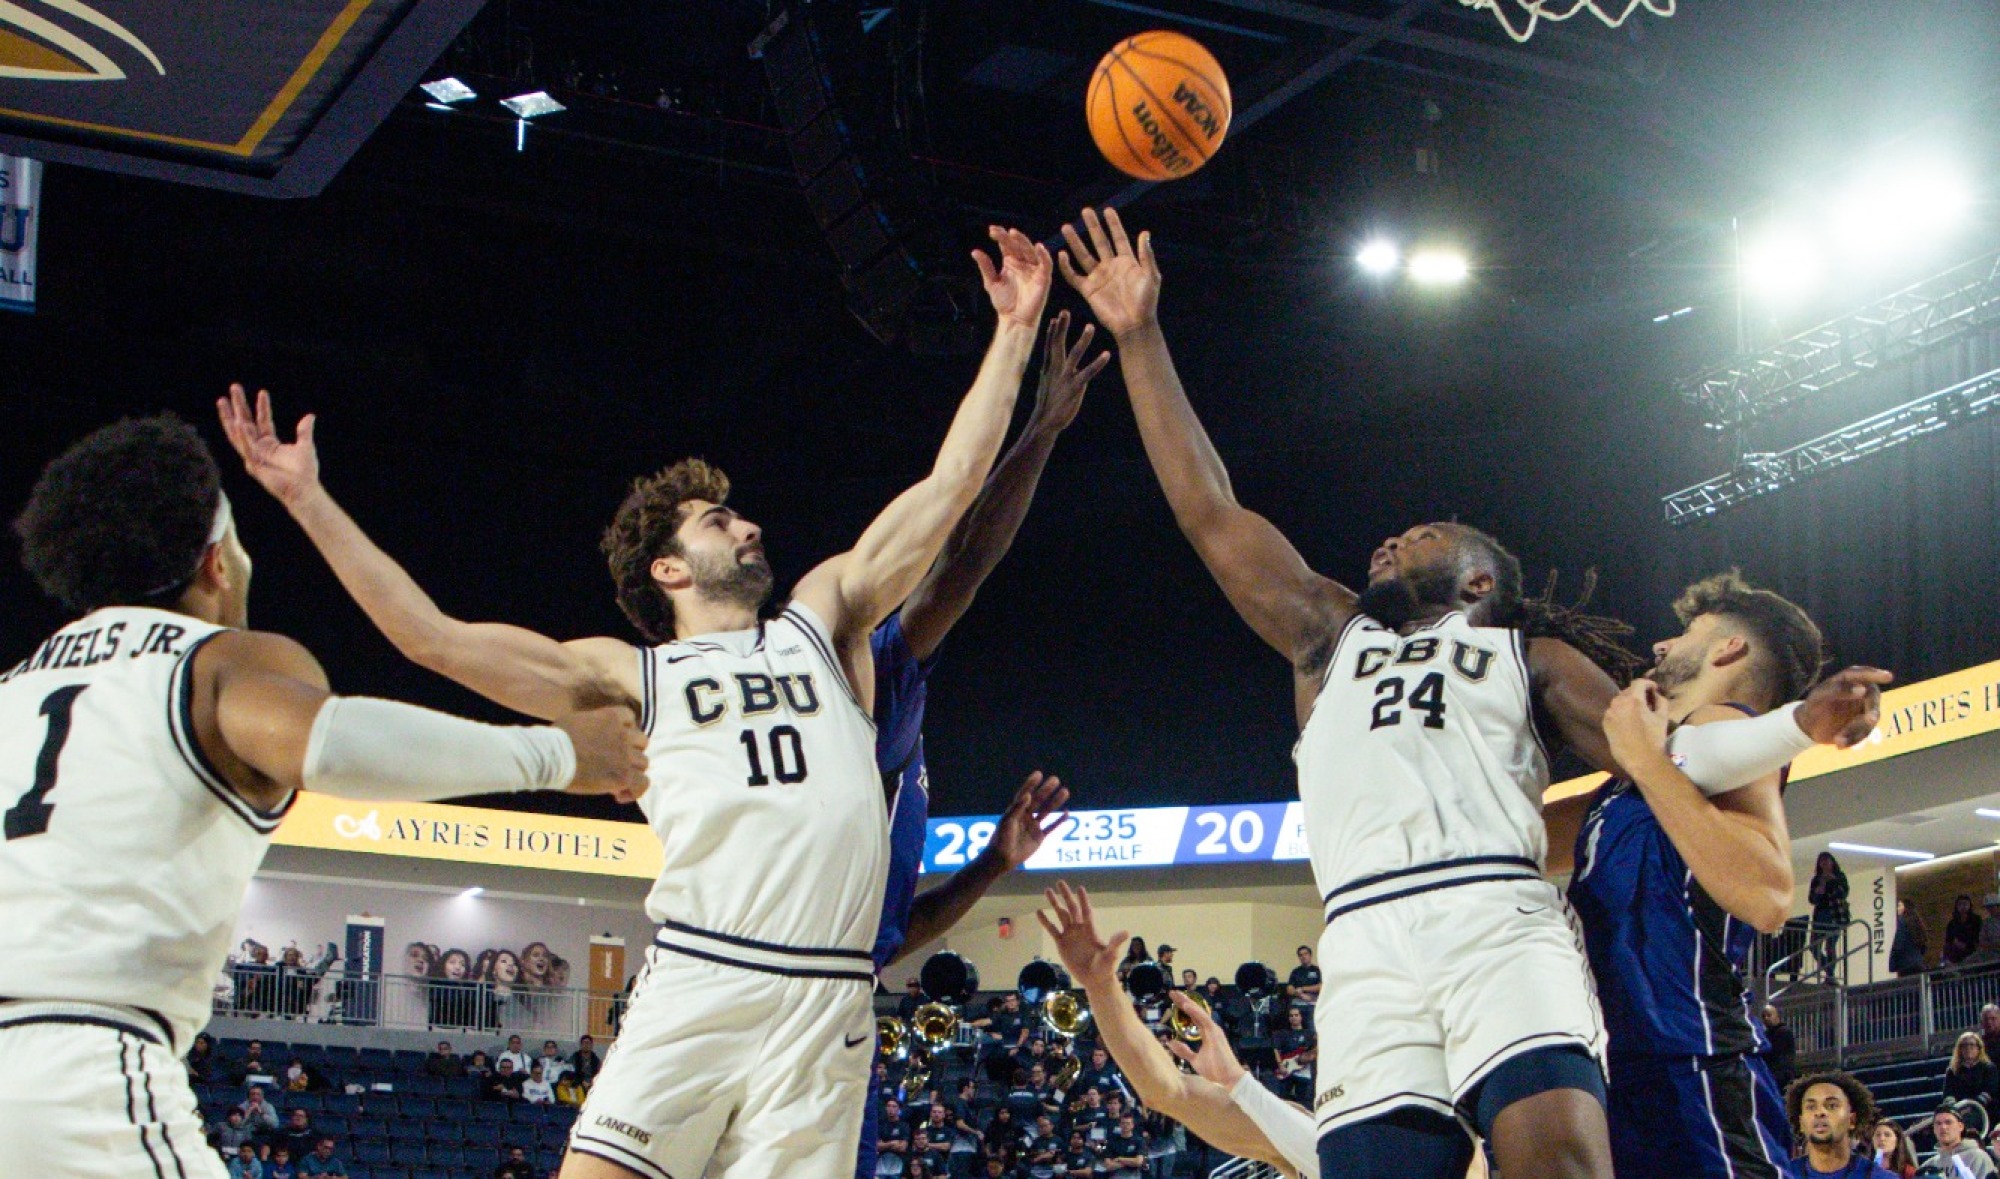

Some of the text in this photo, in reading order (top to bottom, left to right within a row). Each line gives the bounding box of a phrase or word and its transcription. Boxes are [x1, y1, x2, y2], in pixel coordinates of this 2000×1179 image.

[1173, 82, 1220, 139] NCAA
[1352, 637, 1497, 684] CBU
[683, 671, 823, 727] CBU
[1370, 672, 1446, 731] 24
[1887, 690, 1971, 738] AYRES
[4, 684, 91, 840] 1
[740, 725, 807, 786] 10
[388, 818, 627, 861] AYRES HOTELS
[1056, 844, 1142, 862] 1st HALF
[1062, 813, 1137, 841] 2:35
[1195, 810, 1264, 855] 20
[1873, 876, 1884, 954] WOMEN
